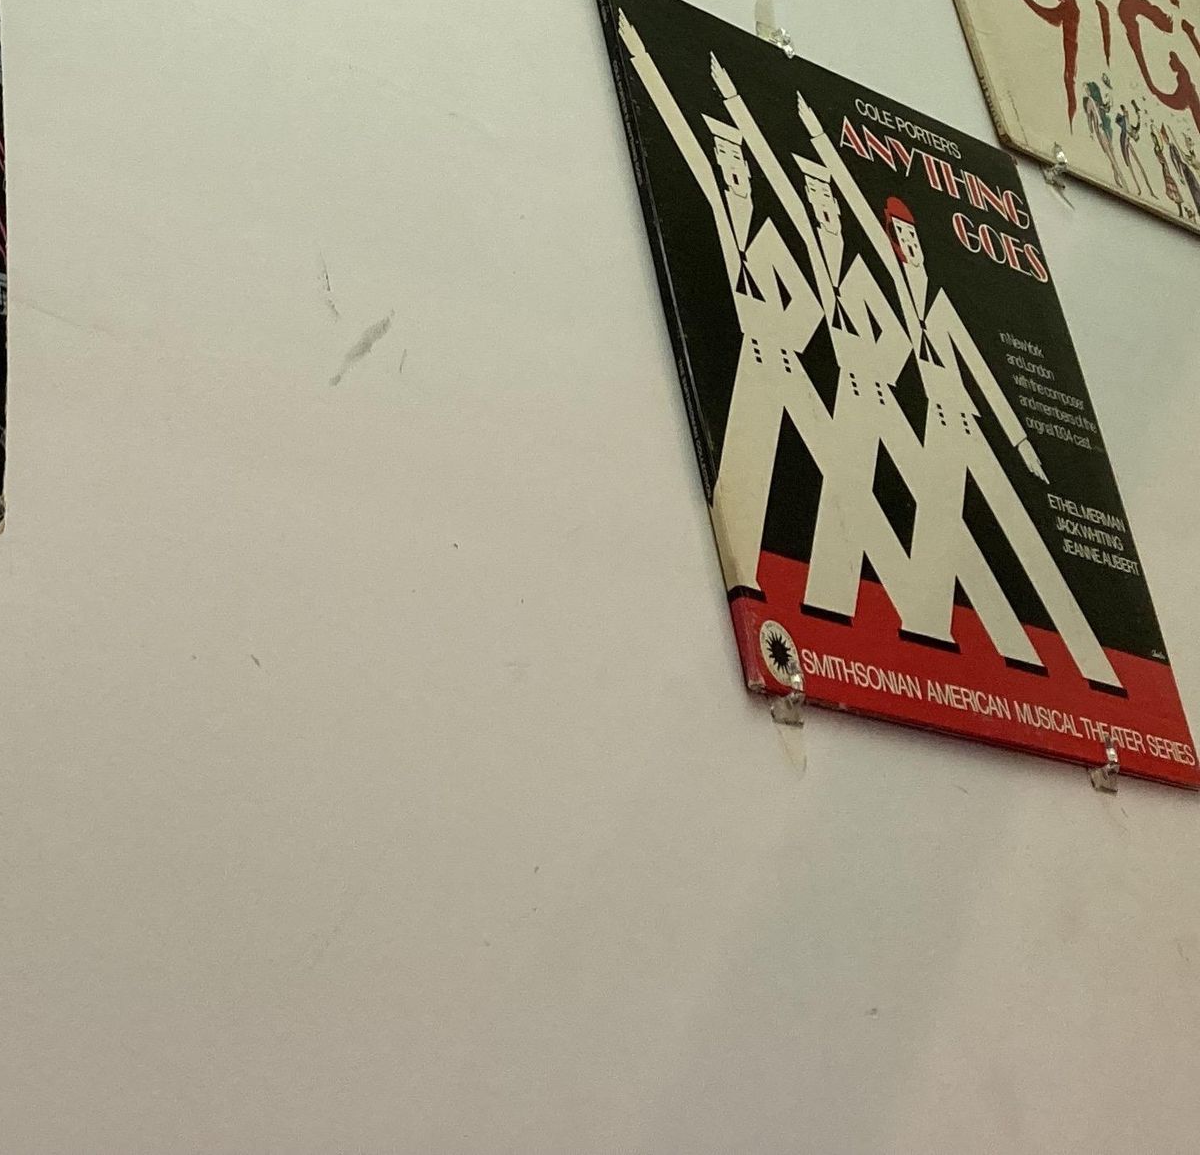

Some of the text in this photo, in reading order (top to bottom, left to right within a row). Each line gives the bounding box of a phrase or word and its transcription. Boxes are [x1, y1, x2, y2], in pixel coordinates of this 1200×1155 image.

[855, 98, 962, 159] COLE PORTER'S
[840, 115, 1030, 230] ANYTHING
[952, 212, 1049, 283] GOES
[1023, 356, 1055, 381] London
[1048, 493, 1126, 534] ETHEL MERMAN
[1056, 517, 1125, 552] JACK WHITING
[1063, 538, 1140, 576] JEANNE AUBERT
[802, 649, 924, 702] SMITHSONIAN
[927, 679, 1012, 722] AMERICAN
[1013, 700, 1084, 739] MUSICAL
[1080, 716, 1147, 755] THEATER
[1146, 734, 1196, 766] SERIES
